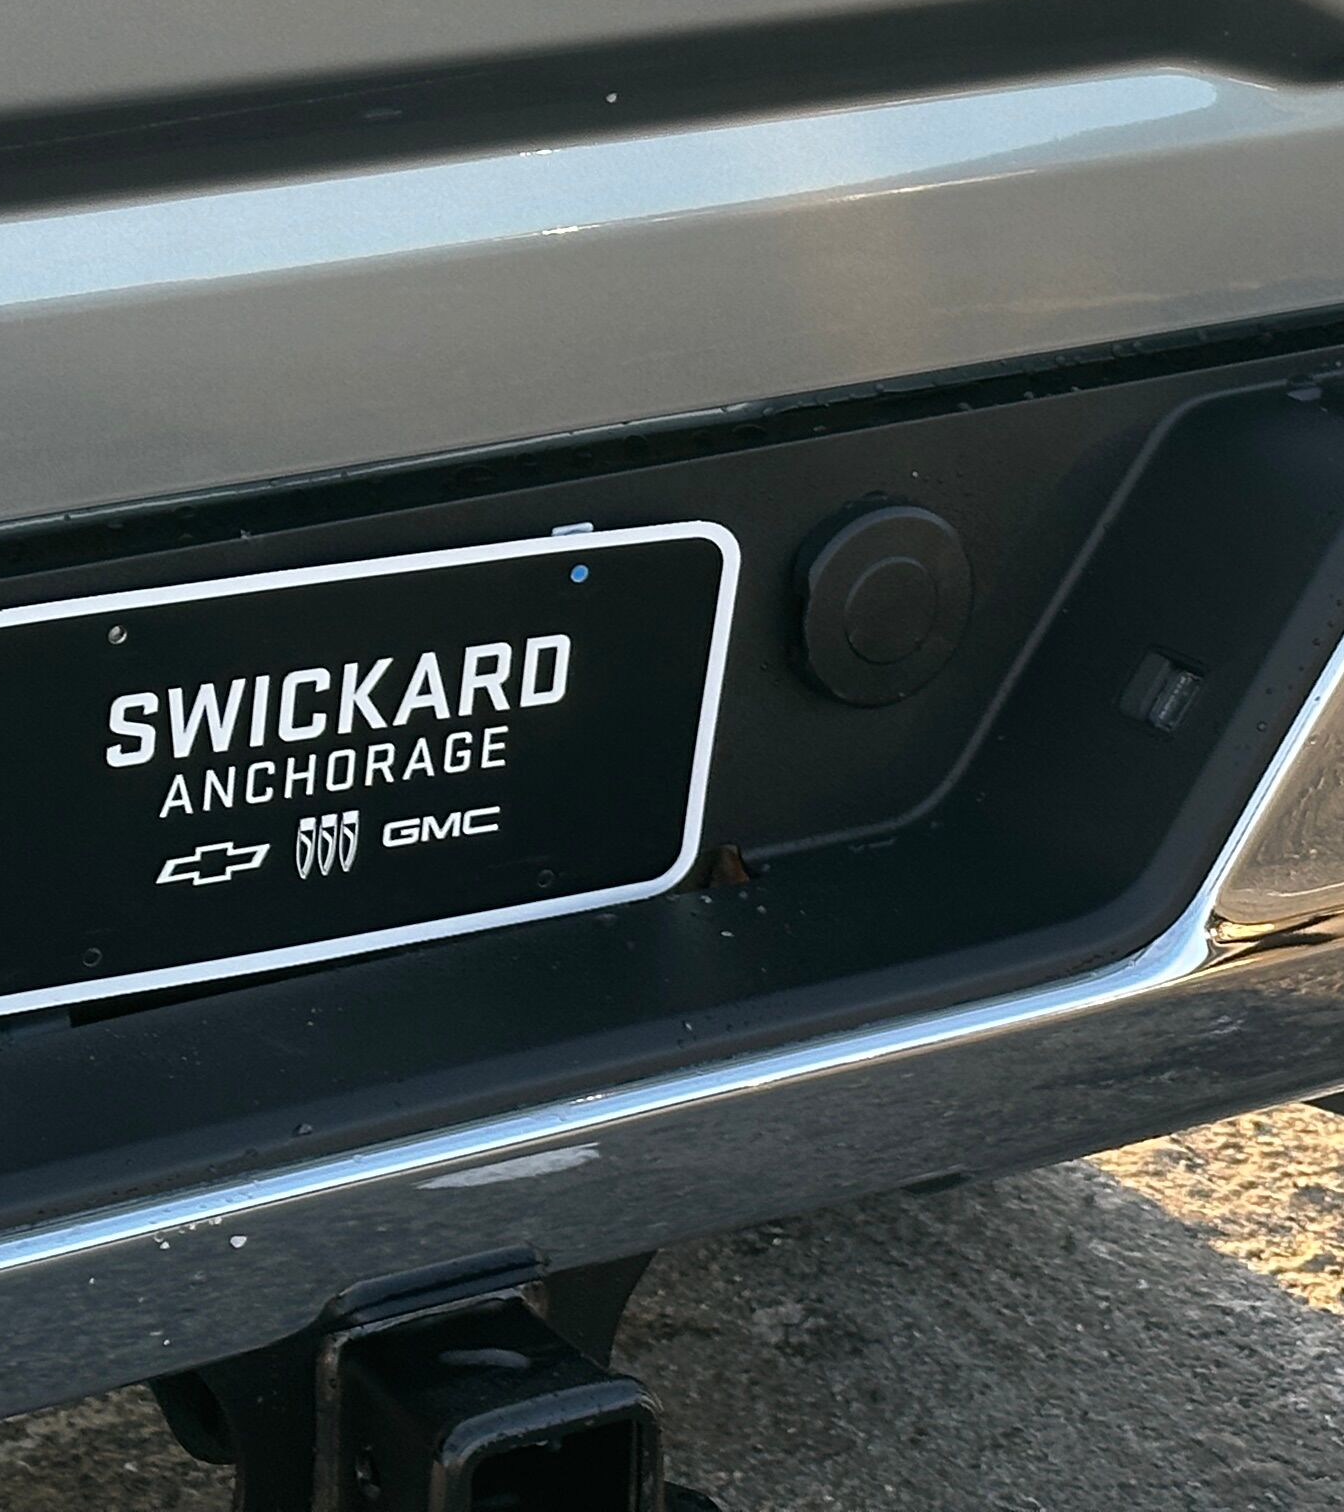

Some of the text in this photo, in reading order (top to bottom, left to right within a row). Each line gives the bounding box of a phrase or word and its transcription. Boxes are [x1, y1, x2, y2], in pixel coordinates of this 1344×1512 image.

[106, 633, 572, 768] SWICKARD
[158, 725, 509, 819] ANCHORAGE
[382, 806, 501, 848] GMC
